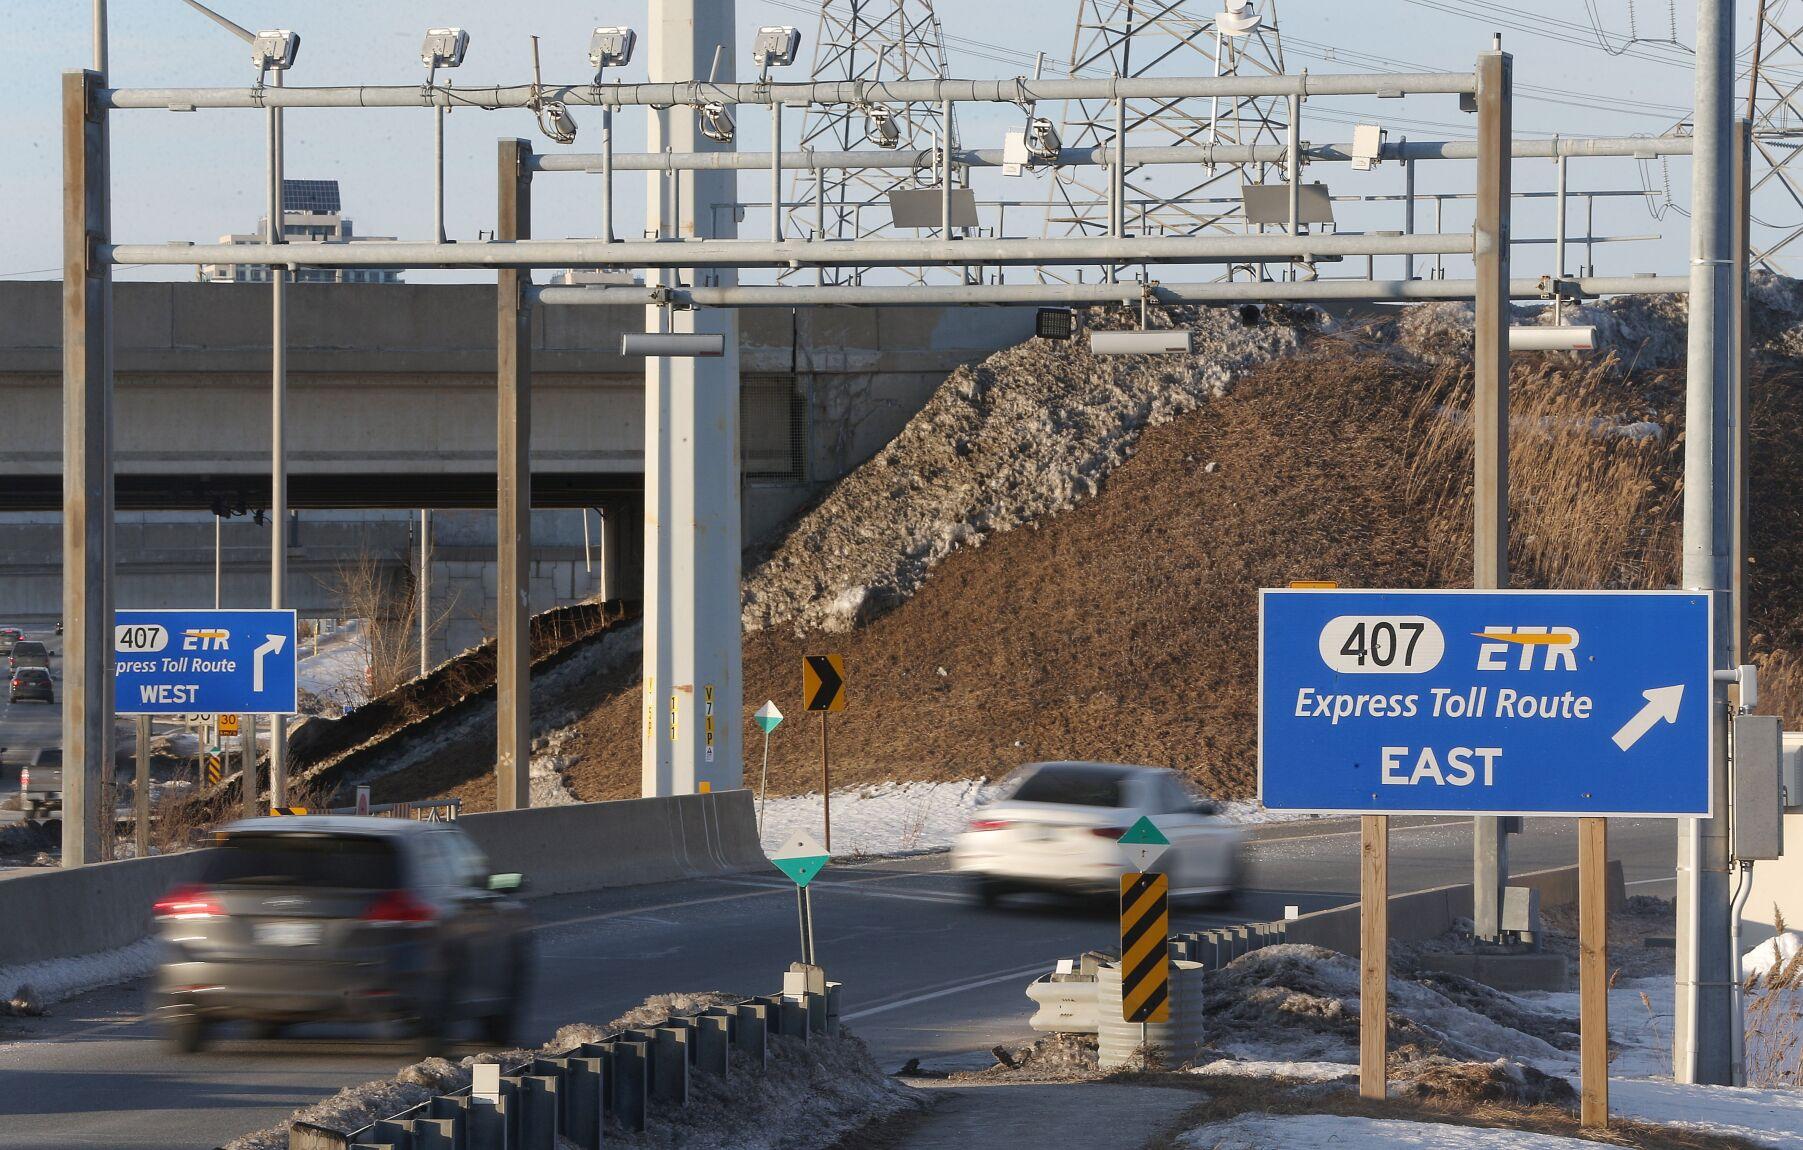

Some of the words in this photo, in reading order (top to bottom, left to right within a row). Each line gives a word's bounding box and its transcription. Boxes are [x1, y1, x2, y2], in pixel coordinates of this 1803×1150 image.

[119, 627, 160, 649] 407
[181, 628, 230, 651] ETR
[1340, 621, 1425, 667] 407
[1475, 626, 1580, 671] ETR
[115, 658, 157, 677] press
[161, 657, 190, 673] Toll
[191, 658, 236, 673] Route
[139, 684, 200, 704] WEST
[1295, 687, 1418, 724] Express
[1430, 686, 1488, 718] Toll
[1495, 688, 1593, 719] Route
[221, 714, 236, 725] 30
[1381, 747, 1502, 787] EAST
